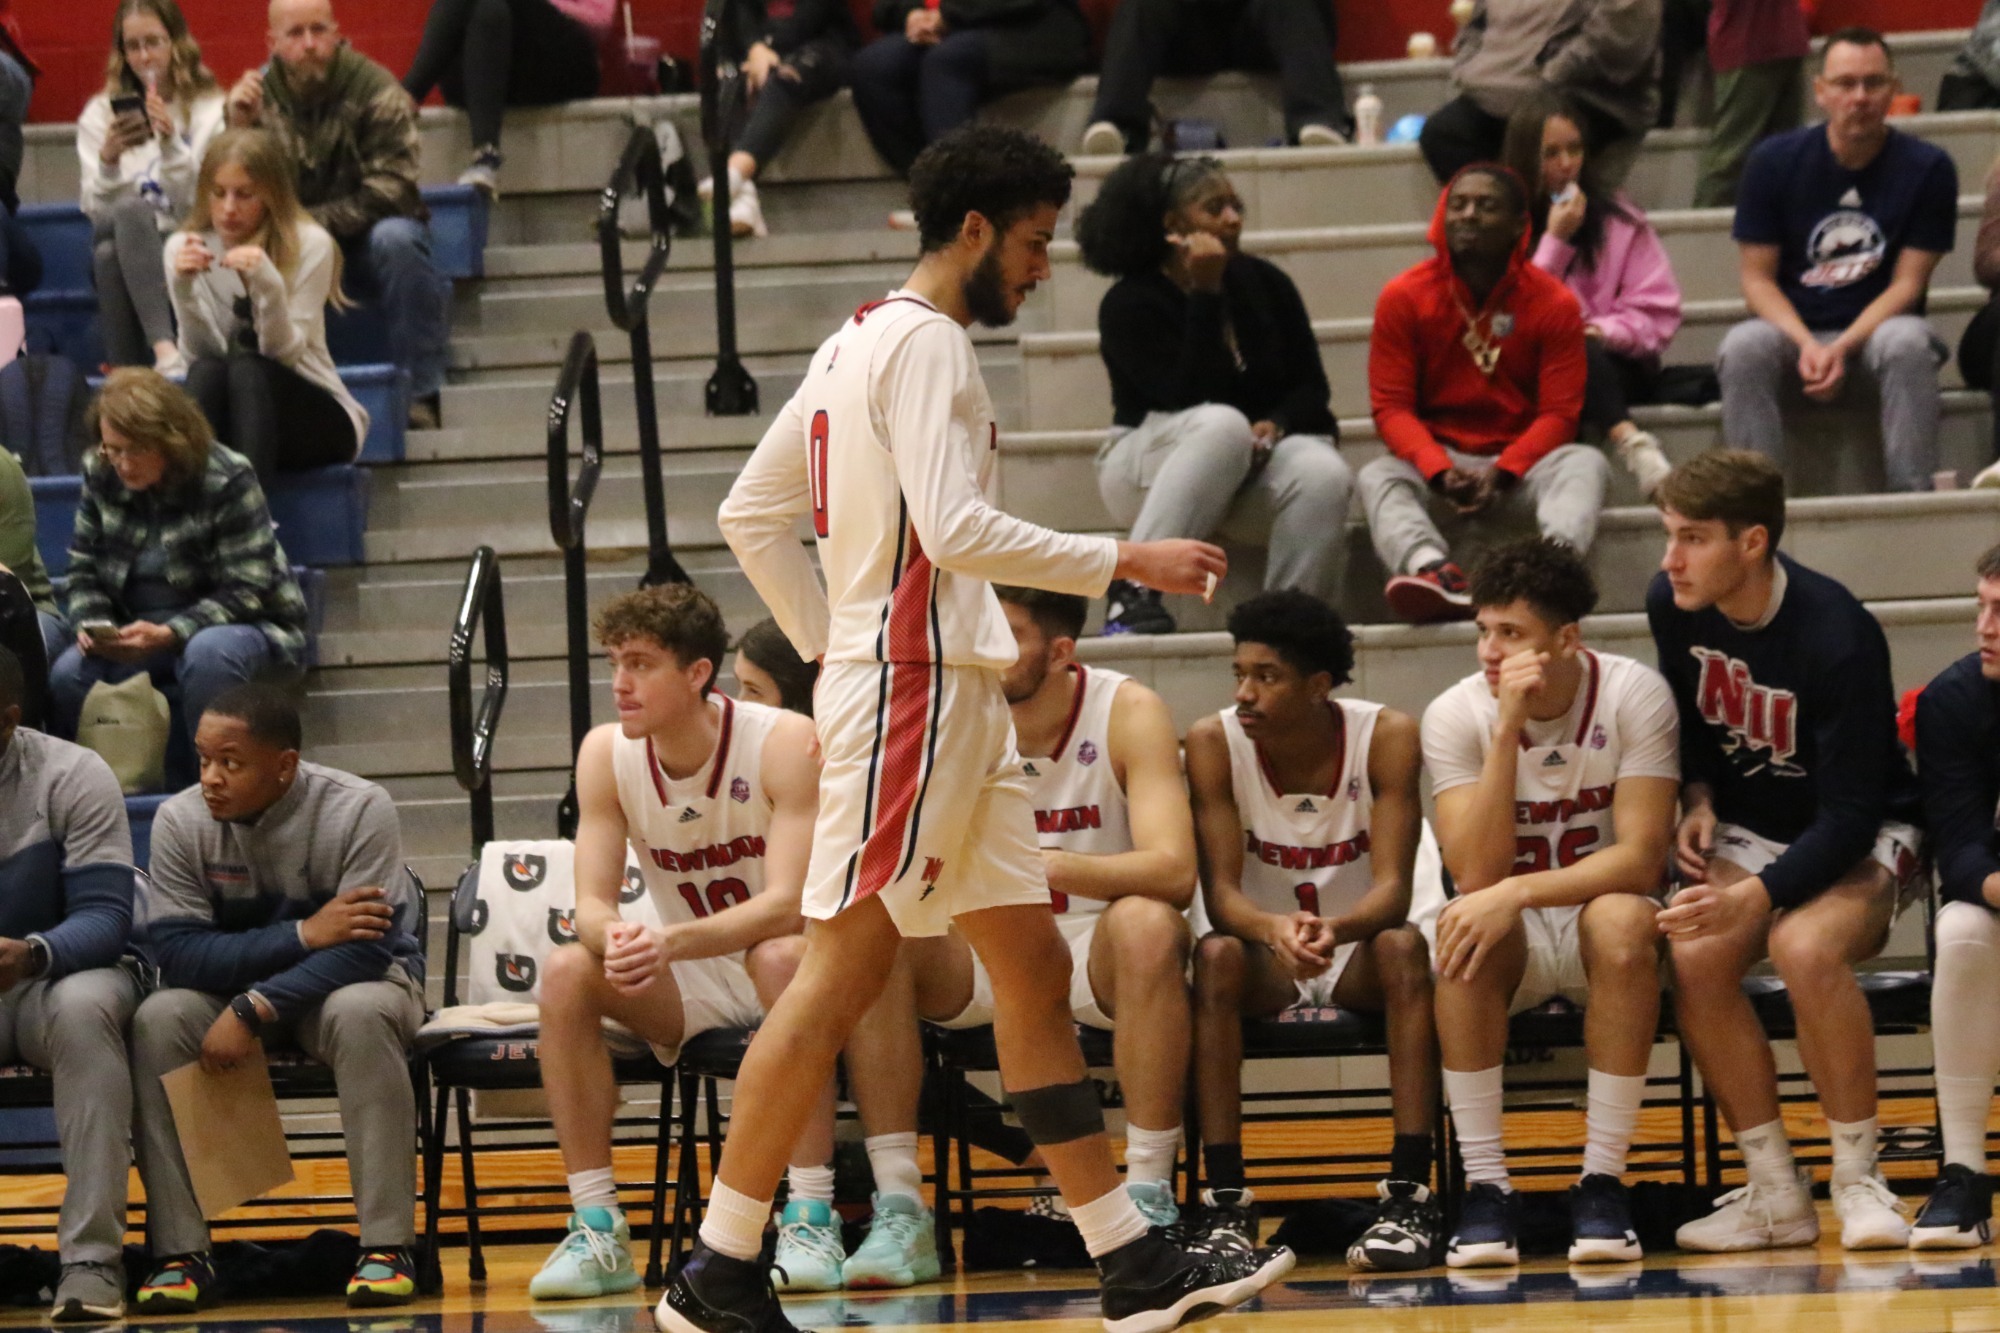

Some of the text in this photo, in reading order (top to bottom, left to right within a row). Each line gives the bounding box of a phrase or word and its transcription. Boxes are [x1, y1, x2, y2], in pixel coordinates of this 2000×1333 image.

[810, 409, 829, 538] 0
[677, 877, 752, 919] 10
[1294, 882, 1320, 917] 1
